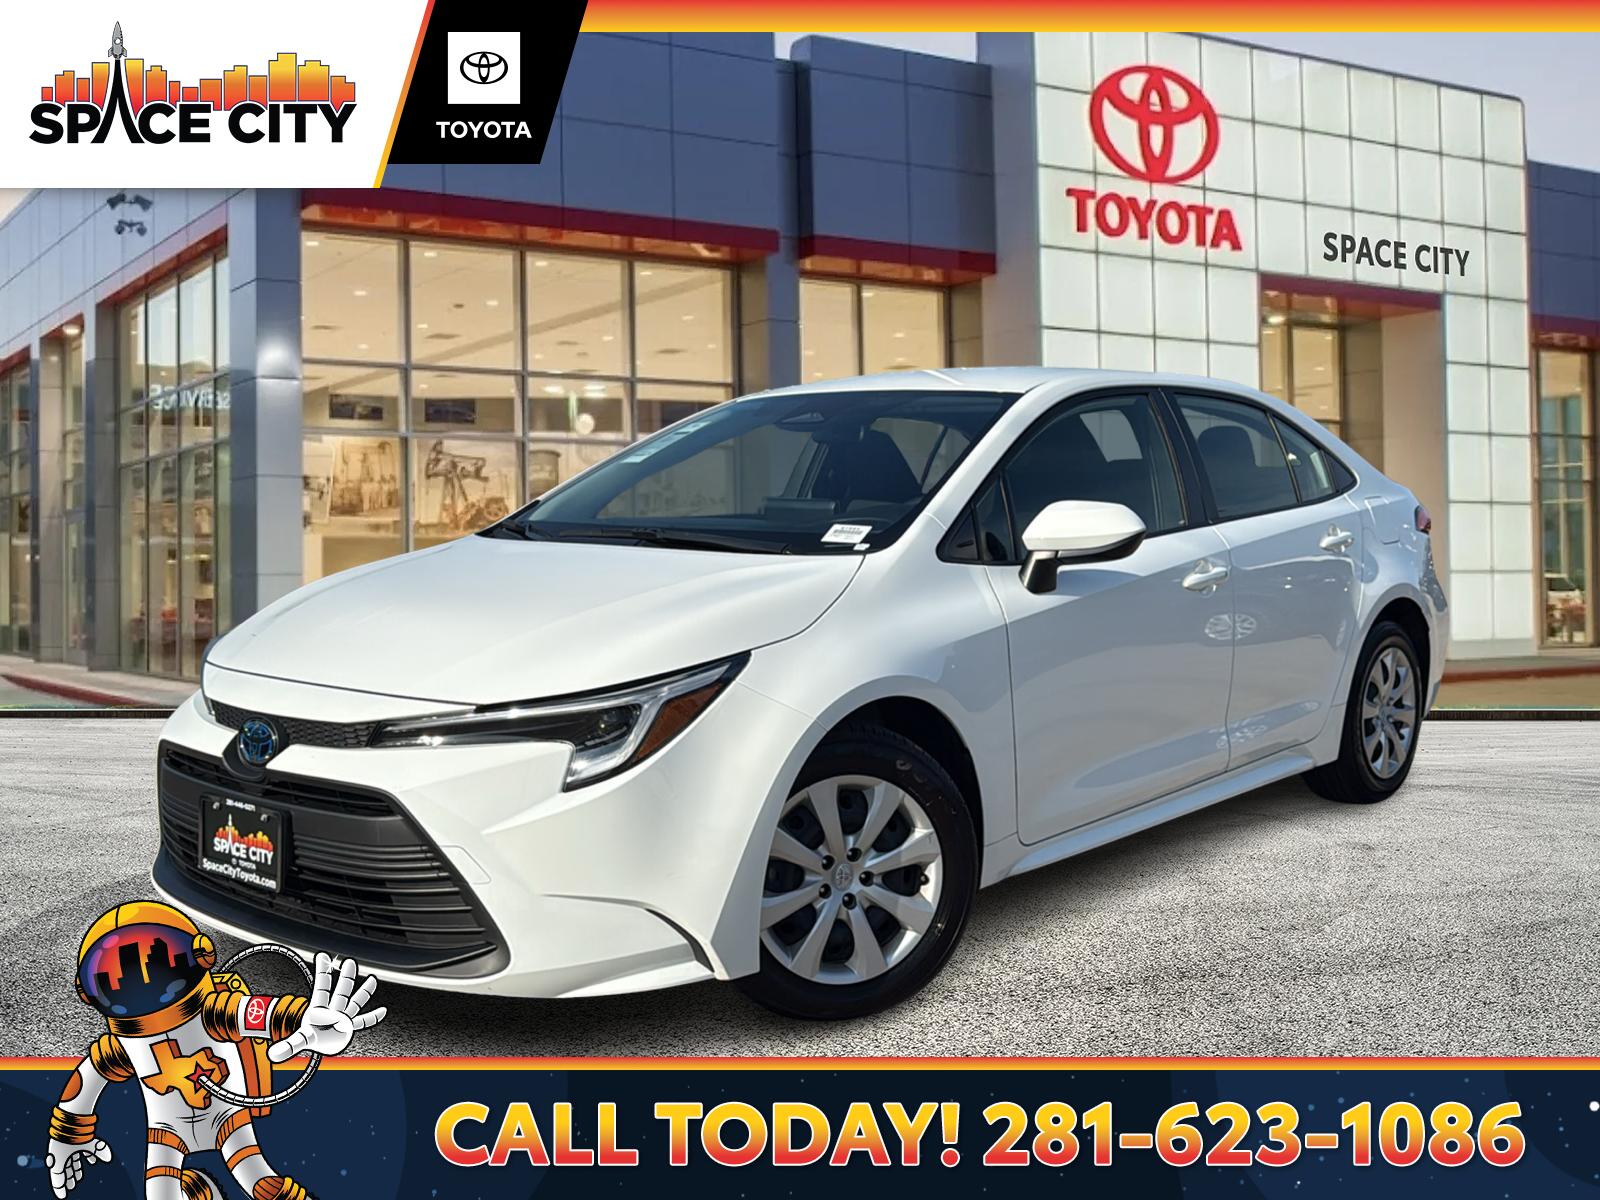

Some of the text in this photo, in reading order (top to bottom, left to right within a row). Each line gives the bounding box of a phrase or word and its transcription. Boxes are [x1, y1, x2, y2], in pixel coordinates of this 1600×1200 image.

[1066, 187, 1242, 251] TOYOTA
[1323, 231, 1470, 277] SPACE CITY
[213, 837, 273, 864] SPACE CITY
[202, 858, 276, 889] SpaceCityToyota.com
